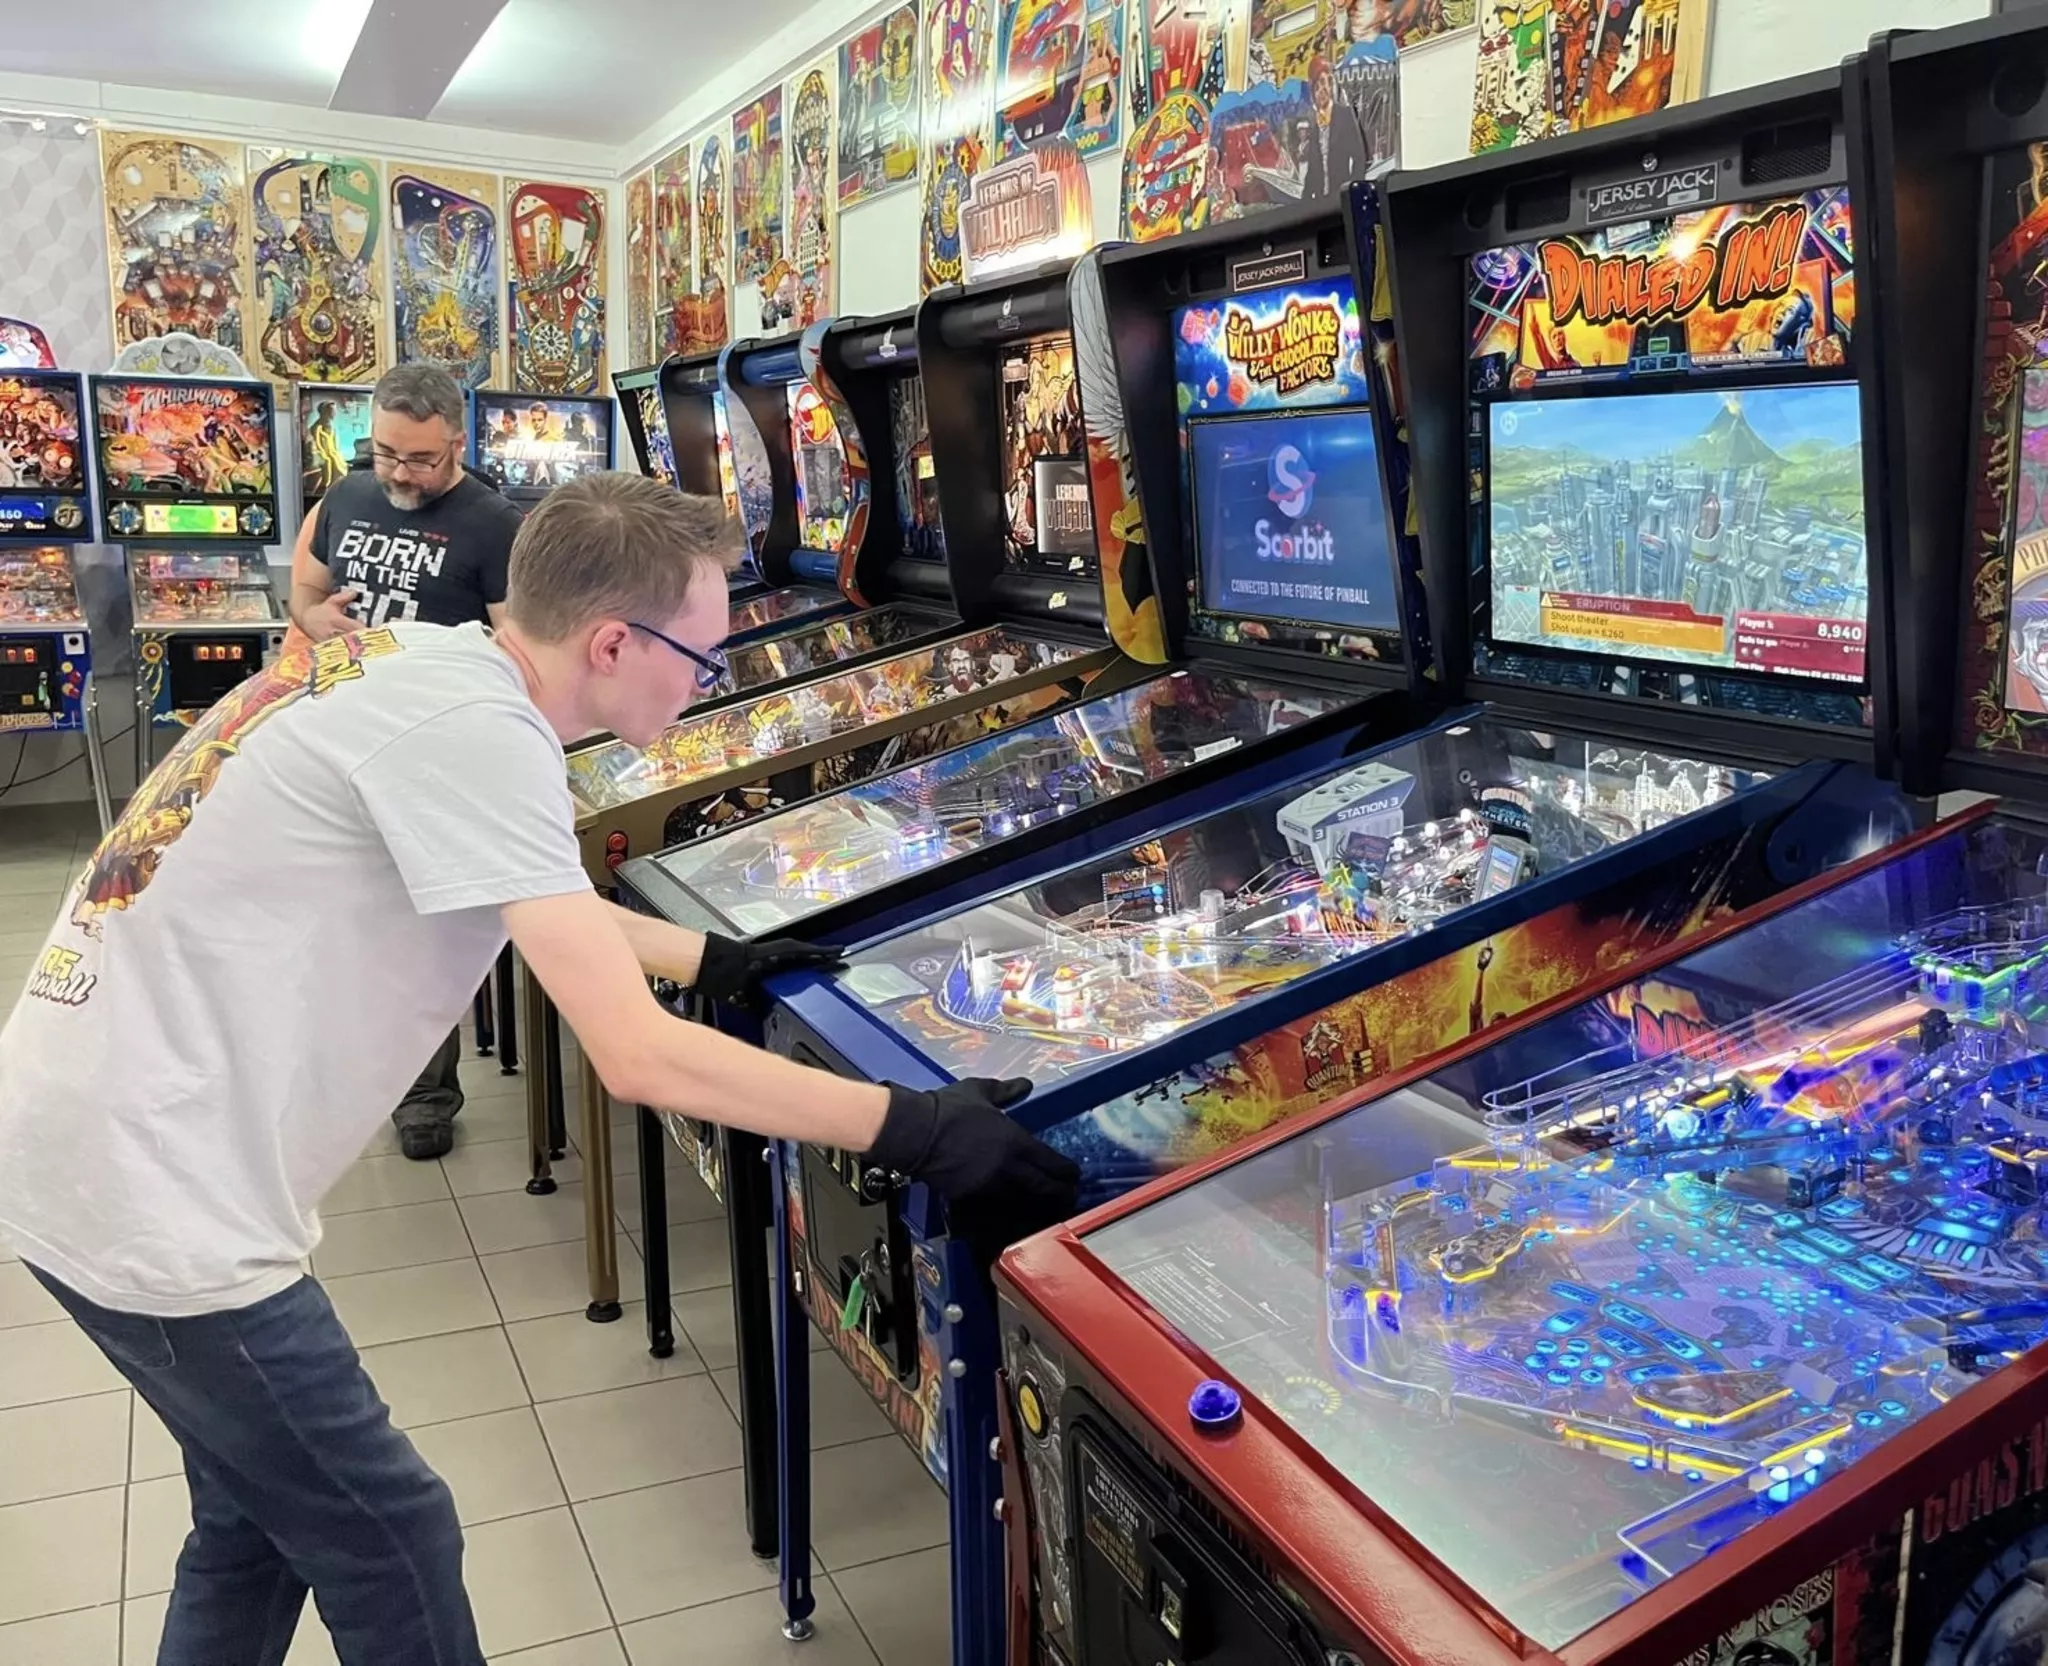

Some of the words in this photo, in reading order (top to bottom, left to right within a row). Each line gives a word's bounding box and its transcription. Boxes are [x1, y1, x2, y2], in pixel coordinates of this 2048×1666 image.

[980, 176, 1018, 207] LEGENDS
[1591, 180, 1657, 212] JERSEY
[1543, 242, 1717, 321] DIALED
[1718, 207, 1805, 307] IN!
[1228, 320, 1276, 360] WILLY
[1277, 305, 1338, 350] WONKA
[1271, 335, 1337, 373] CHOCOLATE
[1279, 355, 1332, 391] FACTORY
[140, 387, 235, 414] WHIRLWIND
[335, 528, 447, 577] BORN
[1254, 518, 1335, 562] Scorbit
[346, 559, 370, 581] IN
[375, 564, 420, 591] THE
[1230, 578, 1269, 596] CONNECTED
[1270, 581, 1280, 596] TO
[1280, 582, 1294, 598] THE
[1294, 583, 1323, 600] FUTURE
[1324, 585, 1335, 601] OF
[1336, 587, 1370, 605] PINBALL
[1576, 596, 1631, 612] ERUPTION
[1550, 611, 1575, 623] Shoot
[1576, 614, 1609, 626] theater
[1550, 622, 1569, 633] Shot
[1570, 626, 1592, 636] value
[1739, 617, 1765, 630] Player
[1337, 799, 1388, 821] STATION
[1390, 796, 1400, 807] 3
[1314, 828, 1324, 840] 3
